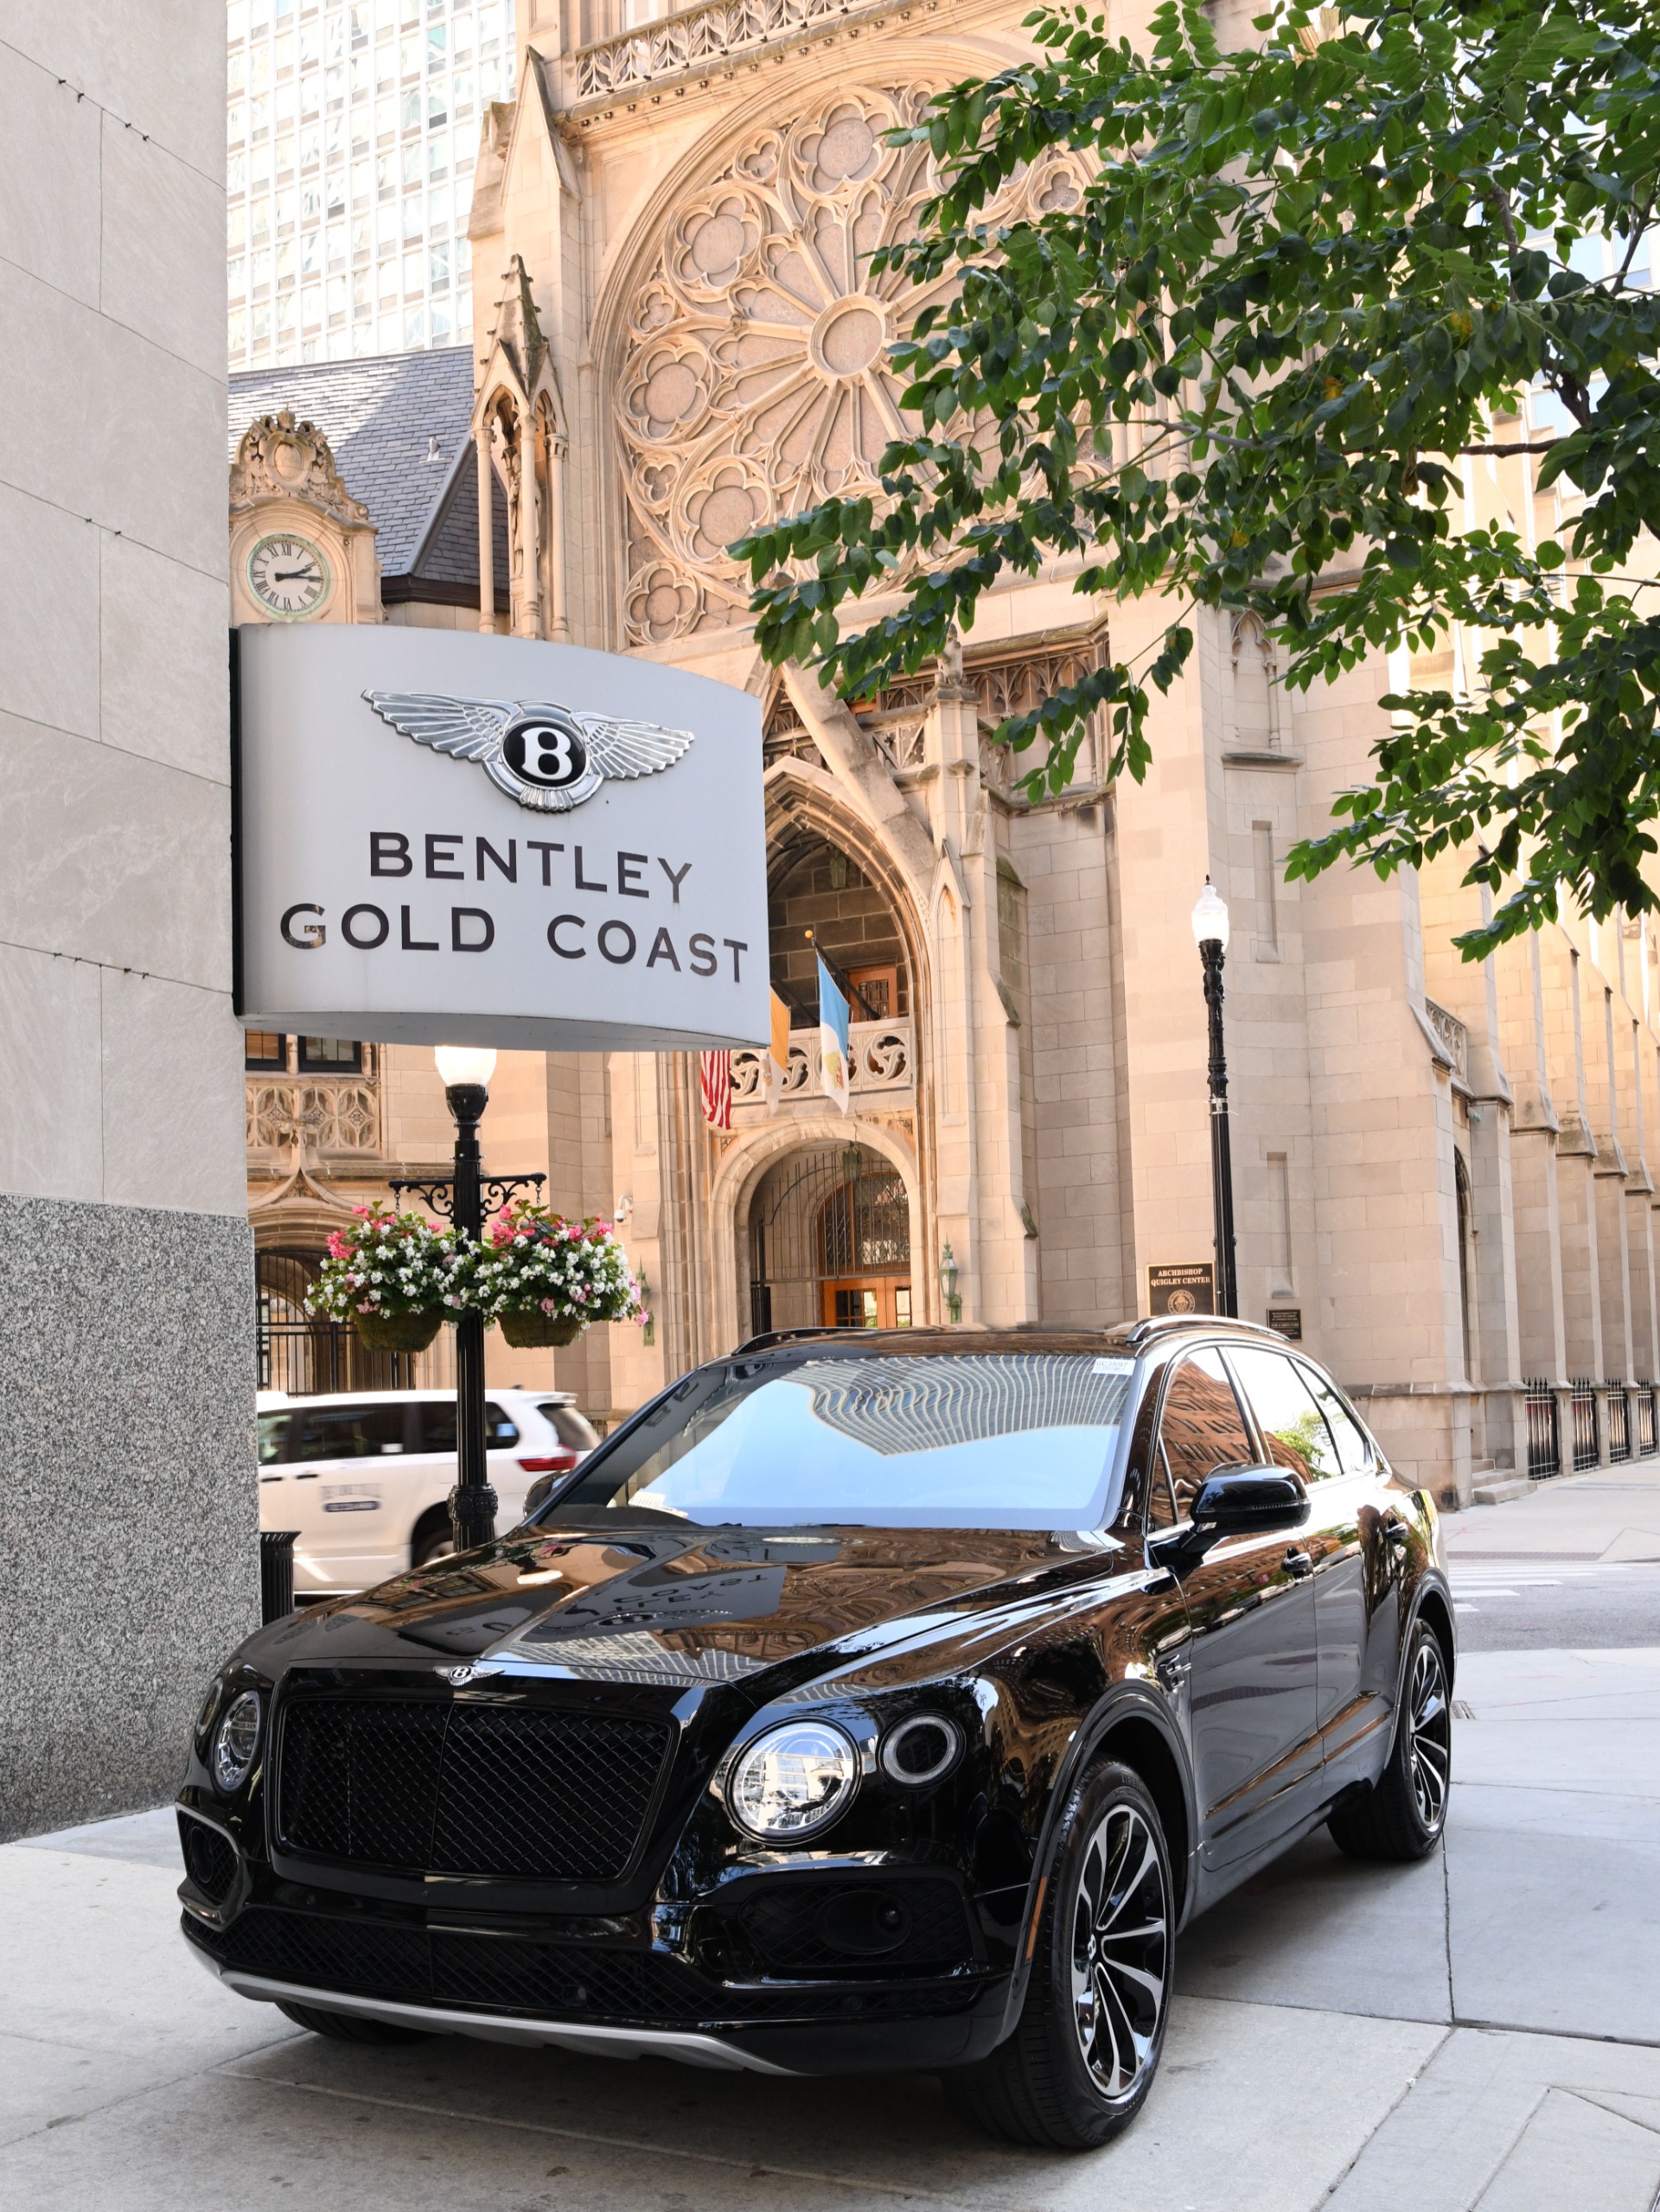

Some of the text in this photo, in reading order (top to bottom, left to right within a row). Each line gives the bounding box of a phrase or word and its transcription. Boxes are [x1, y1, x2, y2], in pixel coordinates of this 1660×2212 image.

[521, 726, 574, 781] B
[369, 831, 693, 904] BENTLEY
[280, 902, 749, 984] GOLD COAST
[1151, 1278, 1182, 1287] QUIGLEY
[1158, 1268, 1203, 1277] ARCHBISHOP
[453, 1667, 469, 1679] B
